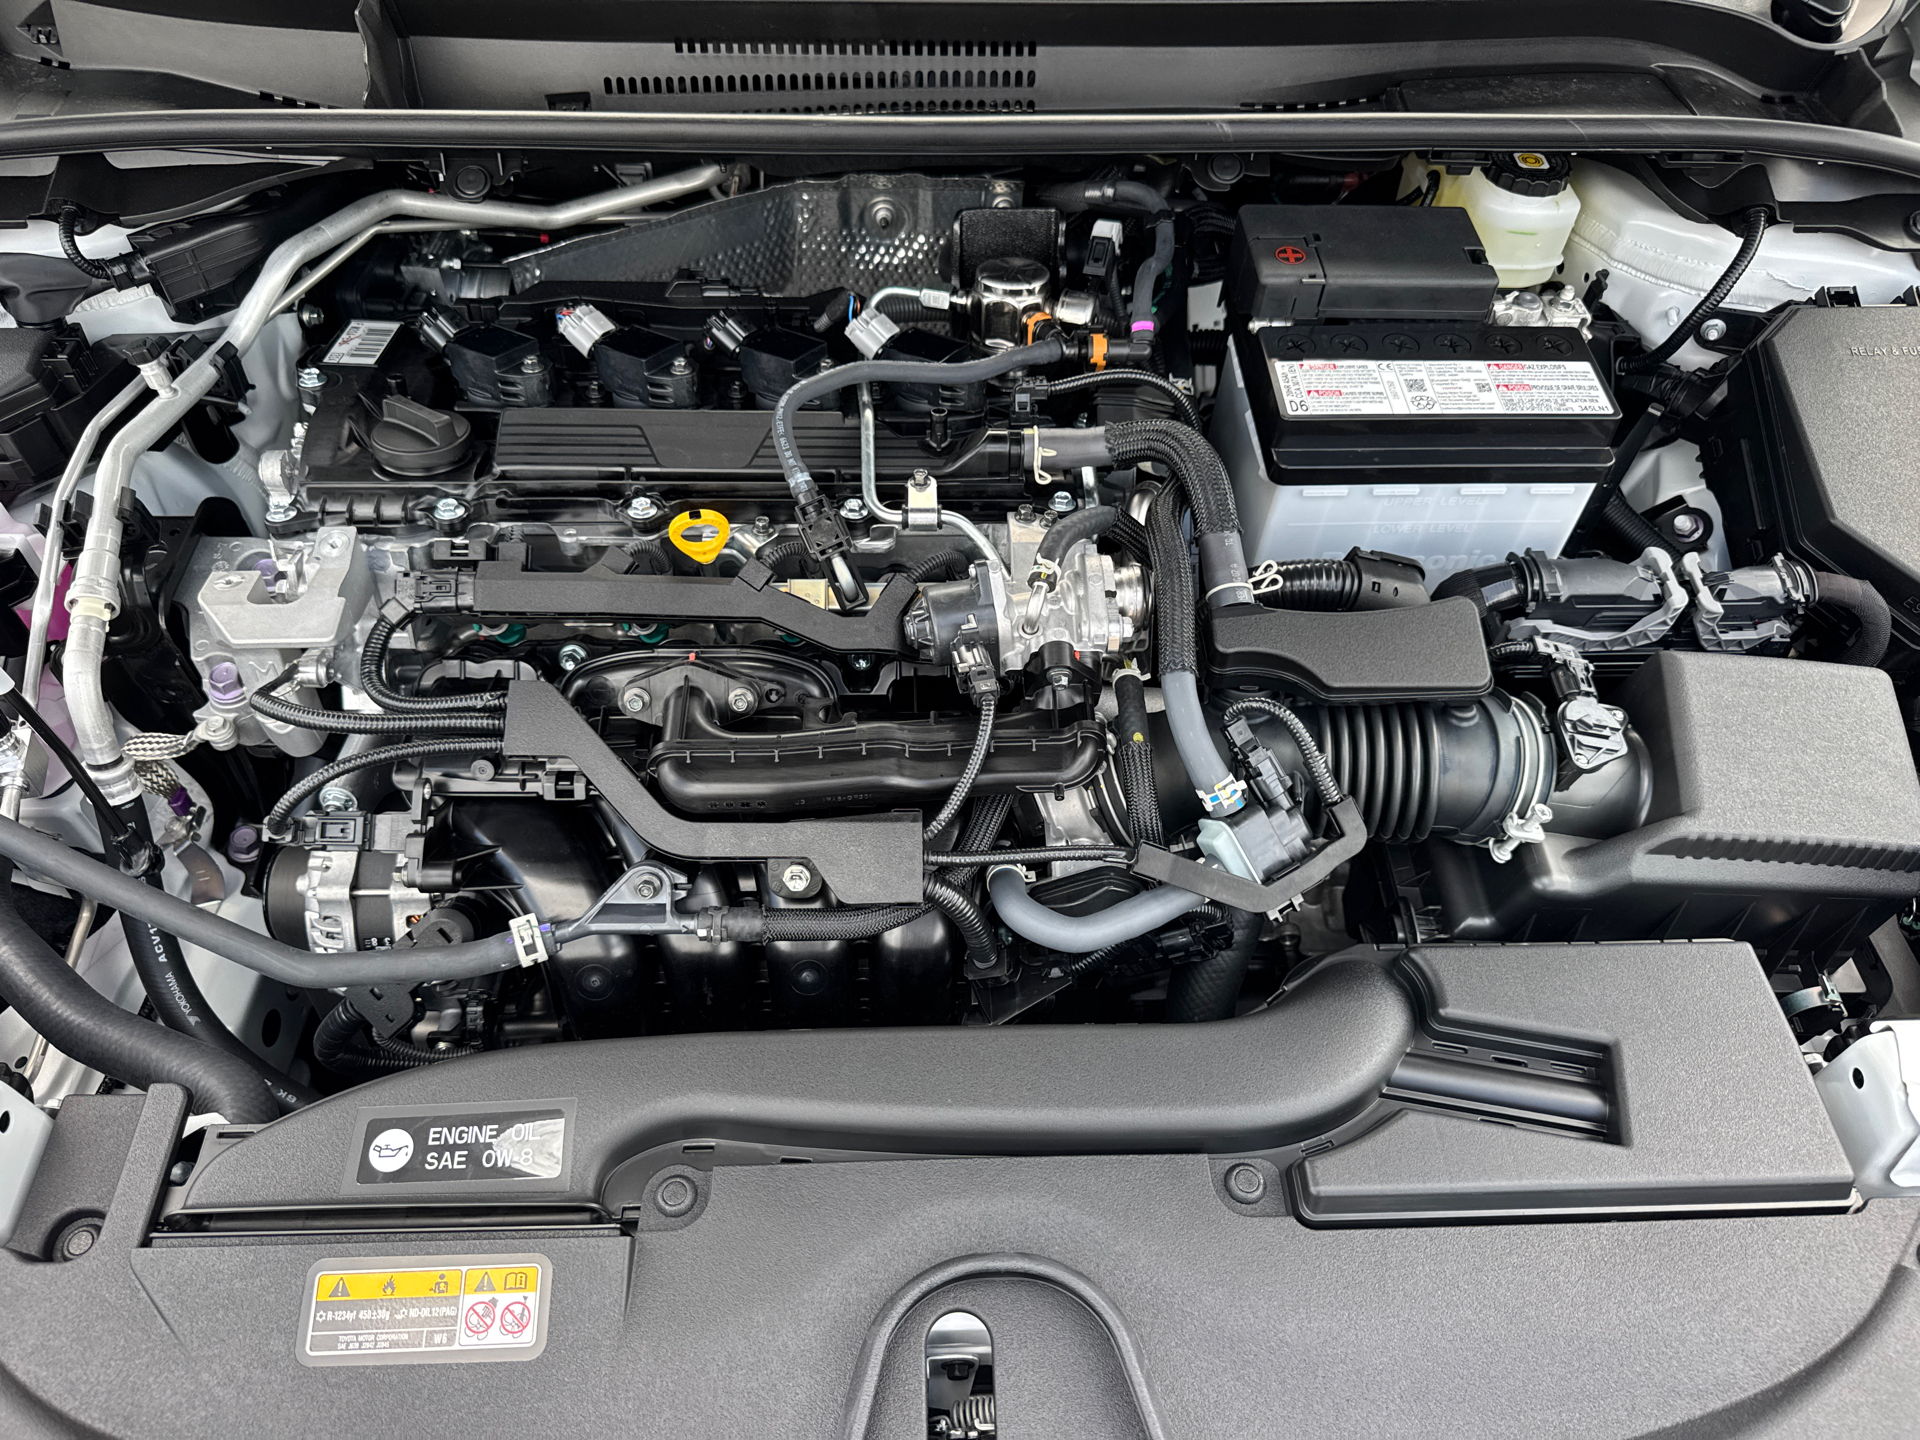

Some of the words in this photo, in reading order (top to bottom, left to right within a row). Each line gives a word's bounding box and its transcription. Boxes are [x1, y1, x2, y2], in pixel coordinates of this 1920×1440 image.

[1850, 346, 1887, 356] RELAY
[1891, 346, 1899, 356] &
[1289, 400, 1309, 412] D6
[1383, 497, 1432, 506] UPPER
[1441, 496, 1485, 506] LEVEL
[1373, 524, 1421, 534] LOWER
[1429, 523, 1471, 533] LEVEL
[164, 971, 193, 1015] YOKOHAMA
[428, 1125, 498, 1145] ENGINE
[511, 1123, 541, 1142] OIL
[424, 1151, 468, 1170] SAE
[481, 1148, 533, 1168] 0W-8
[327, 1310, 356, 1322] R-1234yf
[358, 1310, 391, 1321] 450±30g
[376, 1333, 409, 1341] CORPORATION
[434, 1333, 448, 1344] W6
